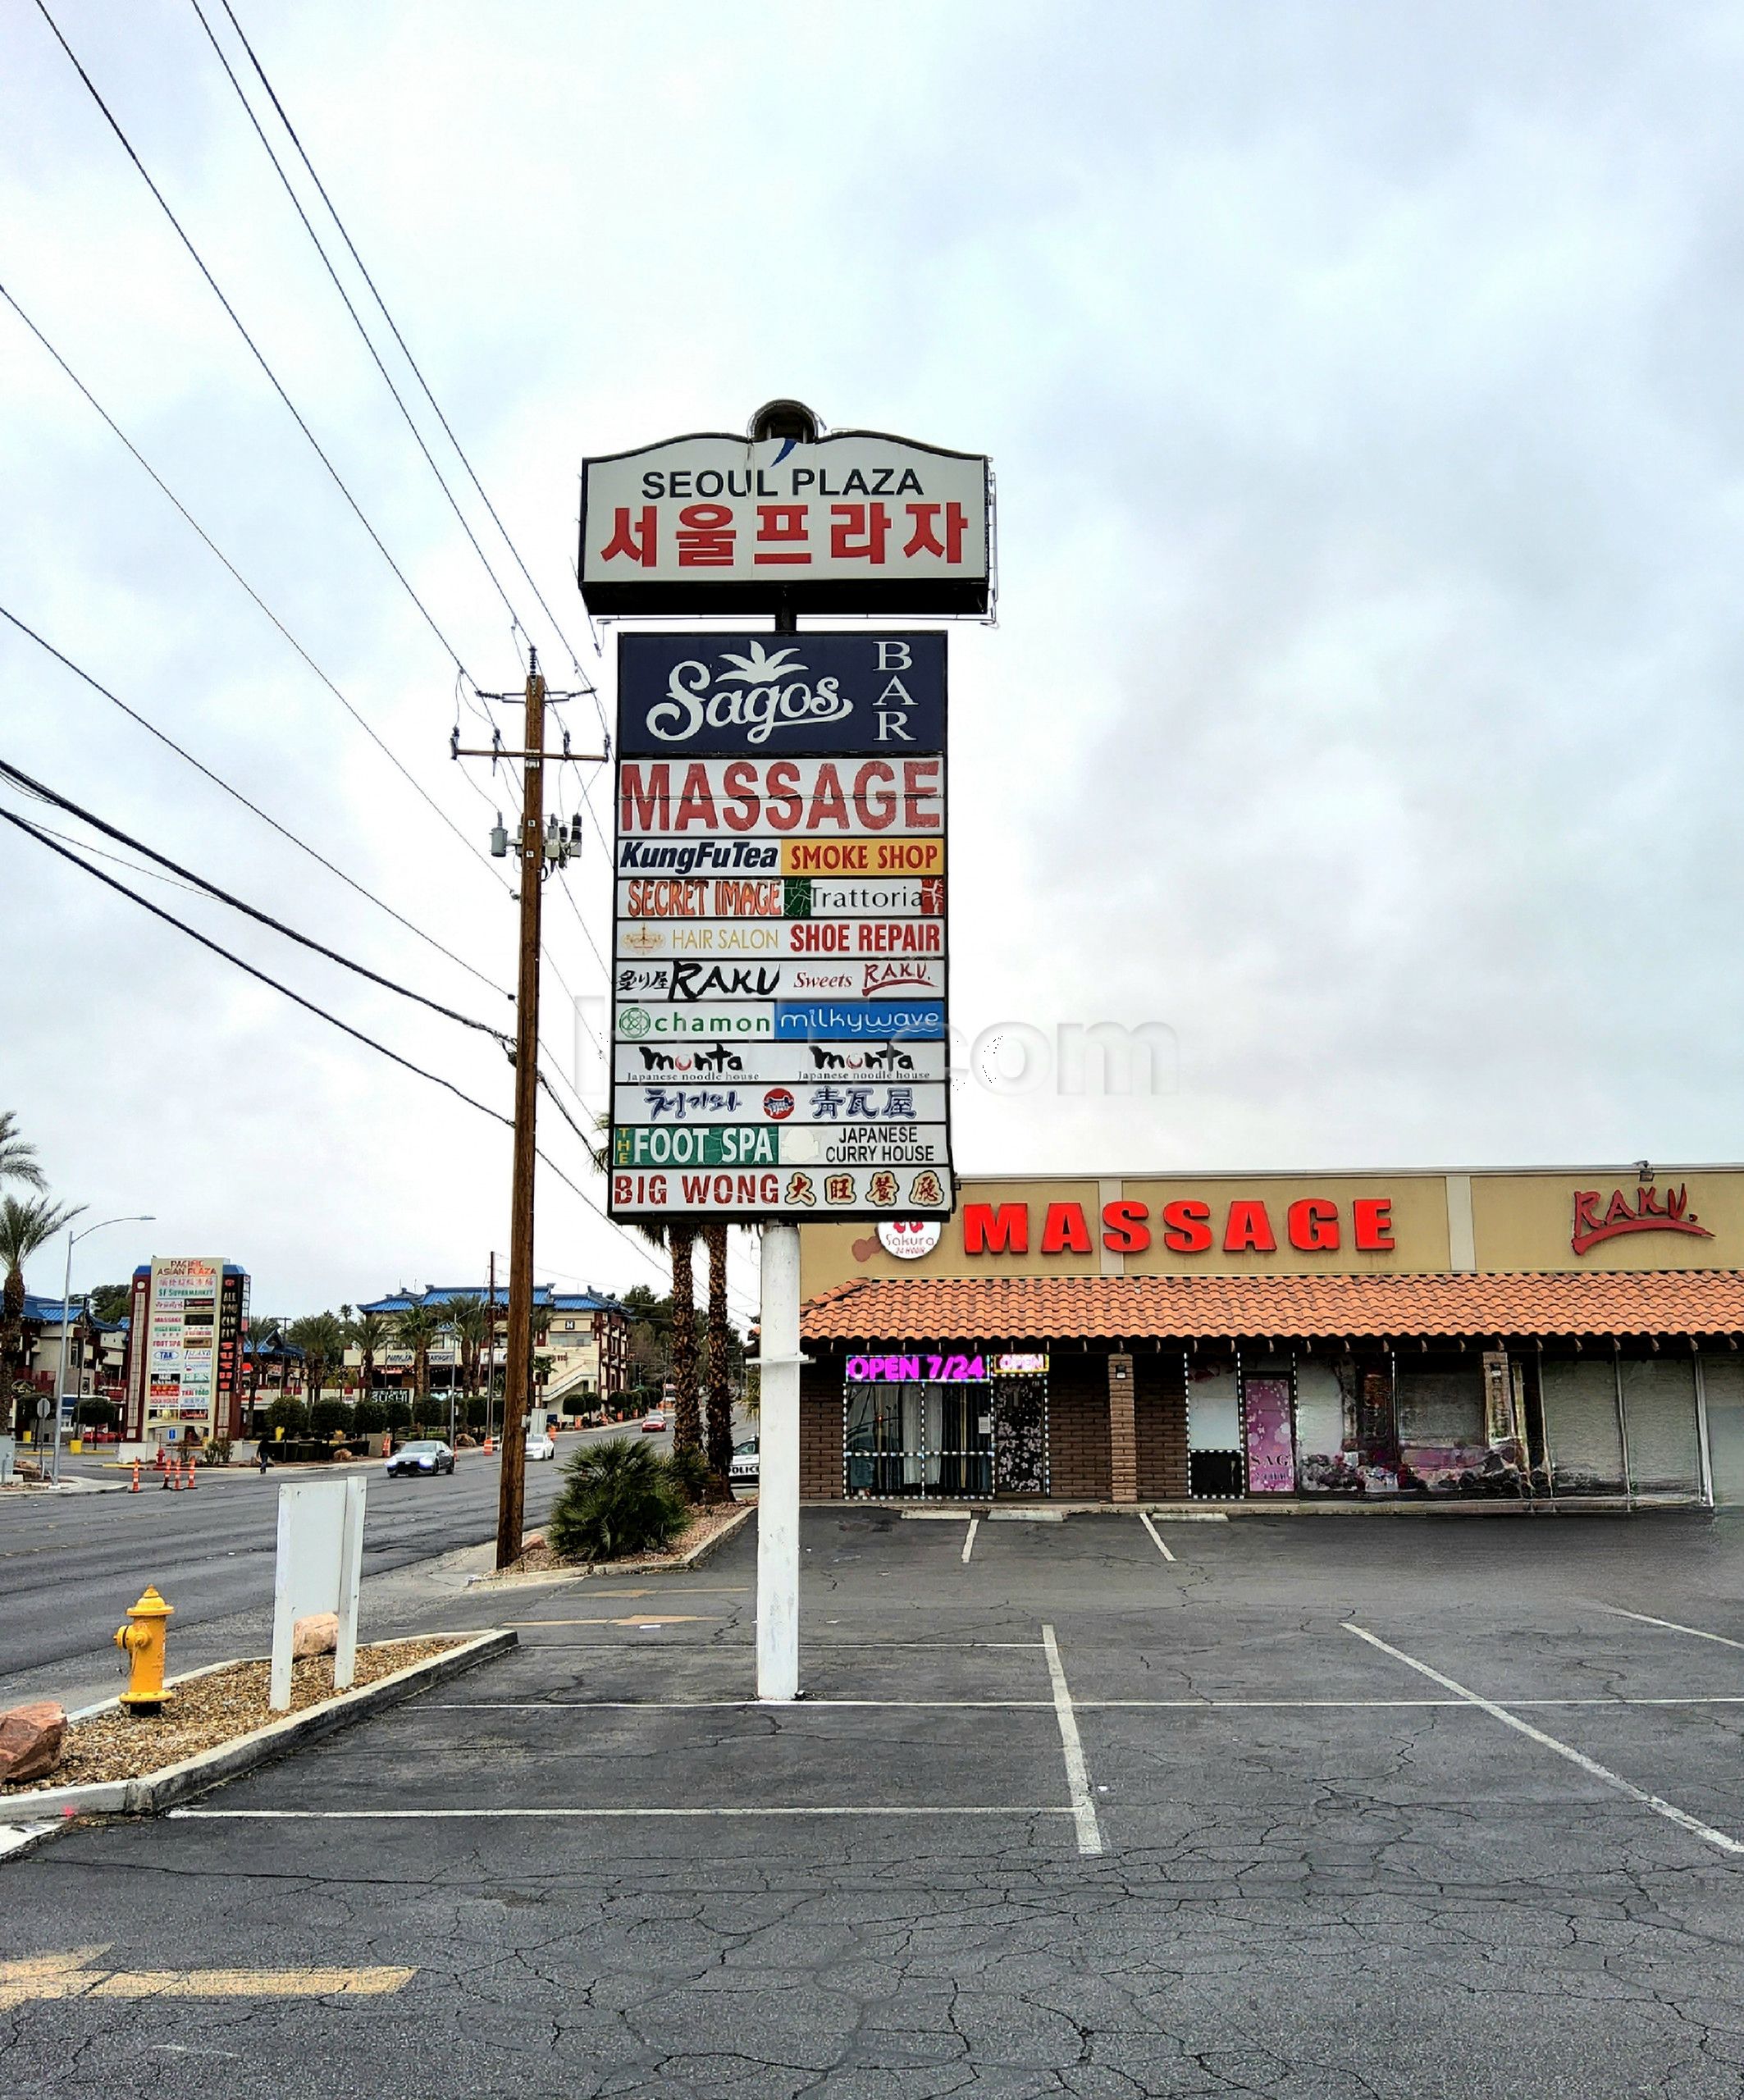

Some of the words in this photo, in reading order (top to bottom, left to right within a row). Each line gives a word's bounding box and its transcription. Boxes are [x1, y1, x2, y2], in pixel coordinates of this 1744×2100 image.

[641, 469, 778, 500] SEOUL
[792, 468, 925, 496] PLAZA
[600, 502, 969, 568] 서울프라자
[646, 660, 854, 744] Sagos
[621, 760, 940, 832] MASSAGE
[620, 842, 778, 874] KungFuTea
[790, 845, 869, 870] SMOKE
[878, 844, 938, 870] SHOP
[628, 879, 709, 916] SECRET
[714, 879, 782, 916] IMAGE
[810, 886, 923, 908] Trattoria
[672, 929, 713, 949] HAIR
[718, 929, 778, 949] SALON
[790, 924, 850, 952] SHOE
[859, 924, 940, 952] REPAIR
[668, 960, 781, 1001] RAKU
[793, 970, 853, 990] Sweets
[655, 1011, 771, 1033] chamon
[780, 1007, 938, 1034] milkywave
[627, 1071, 678, 1082] Japanese
[682, 1071, 722, 1081] noodle
[725, 1071, 760, 1081] house
[798, 1071, 850, 1081] Japanese
[853, 1071, 893, 1080] noodle
[896, 1071, 930, 1080] house
[616, 1128, 630, 1165] THE
[633, 1127, 711, 1163] FOOT
[721, 1127, 775, 1162] SPA
[838, 1126, 918, 1144] JAPANESE
[825, 1145, 877, 1162] CURRY
[883, 1144, 934, 1162] HOUSE
[614, 1174, 667, 1204] BIG
[682, 1174, 779, 1204] WONG
[963, 1198, 1395, 1254] MASSAGE
[886, 1234, 934, 1246] Sakura
[157, 1267, 185, 1276] ASIAN
[187, 1267, 217, 1276] PLAZA
[847, 1357, 920, 1380] OPEN
[927, 1356, 985, 1380] 7/24
[999, 1354, 1044, 1369] OPEN
